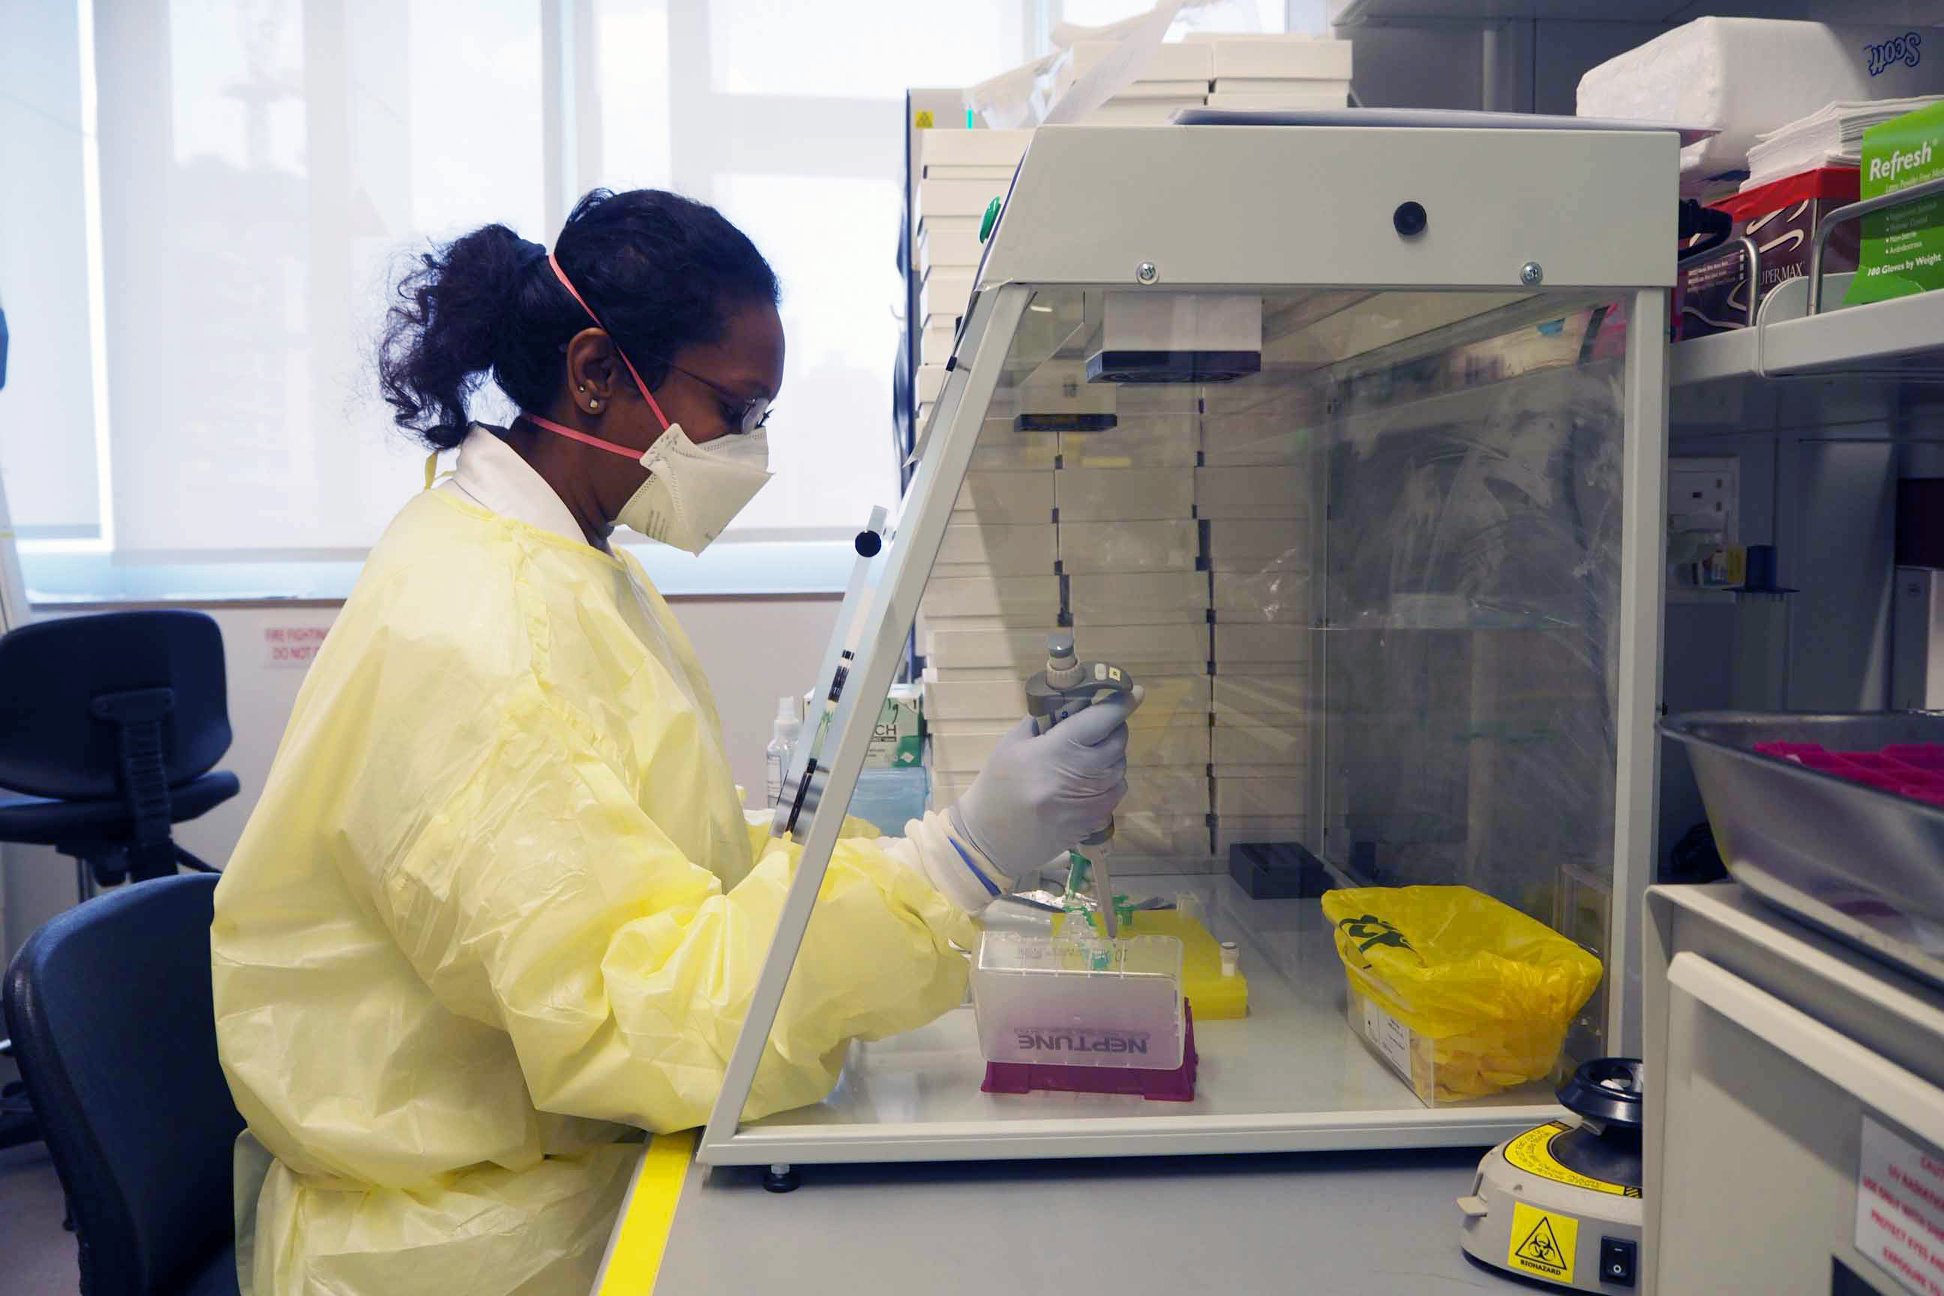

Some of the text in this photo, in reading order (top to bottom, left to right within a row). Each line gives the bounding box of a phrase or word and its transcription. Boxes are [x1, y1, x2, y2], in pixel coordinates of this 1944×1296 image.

[1867, 32, 1921, 76] Scott
[1870, 141, 1932, 181] Refresh
[1761, 263, 1803, 286] UPERMAX
[1867, 254, 1942, 276] 100 Gloves by Weight
[1018, 1034, 1147, 1054] NEPTUNE
[1871, 1208, 1907, 1241] PROTECT
[1520, 1259, 1561, 1276] BIOHAZARD
